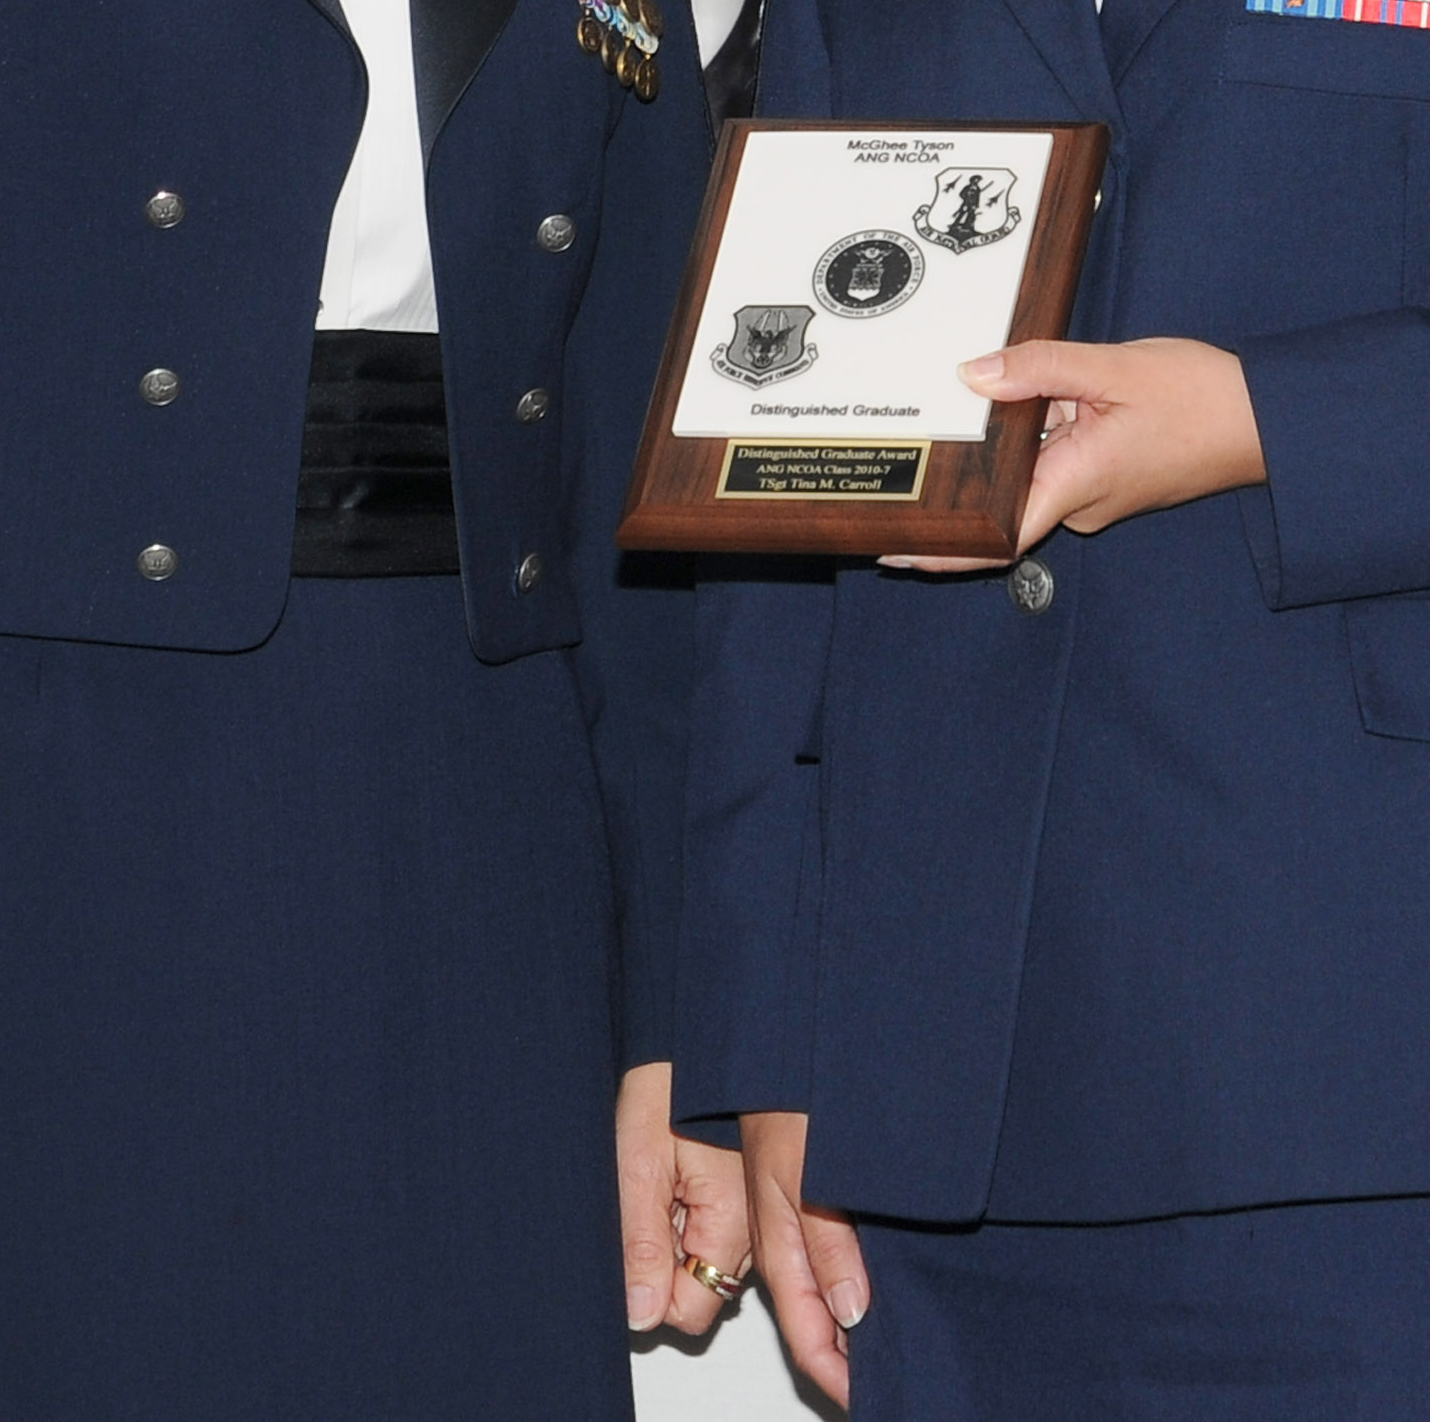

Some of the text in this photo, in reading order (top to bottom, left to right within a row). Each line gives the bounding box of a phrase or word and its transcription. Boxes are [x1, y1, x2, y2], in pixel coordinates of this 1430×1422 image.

[847, 139, 955, 153] McGhee Tyson
[854, 152, 940, 163] ANG NCOA
[750, 403, 921, 418] Distinguished Graduate
[737, 448, 917, 461] Distinguished Graduate Award
[756, 464, 891, 475] ANG NCOA Class 2010-7
[790, 479, 816, 489] Tina
[819, 479, 835, 490] M.
[839, 479, 882, 490] Carroll
